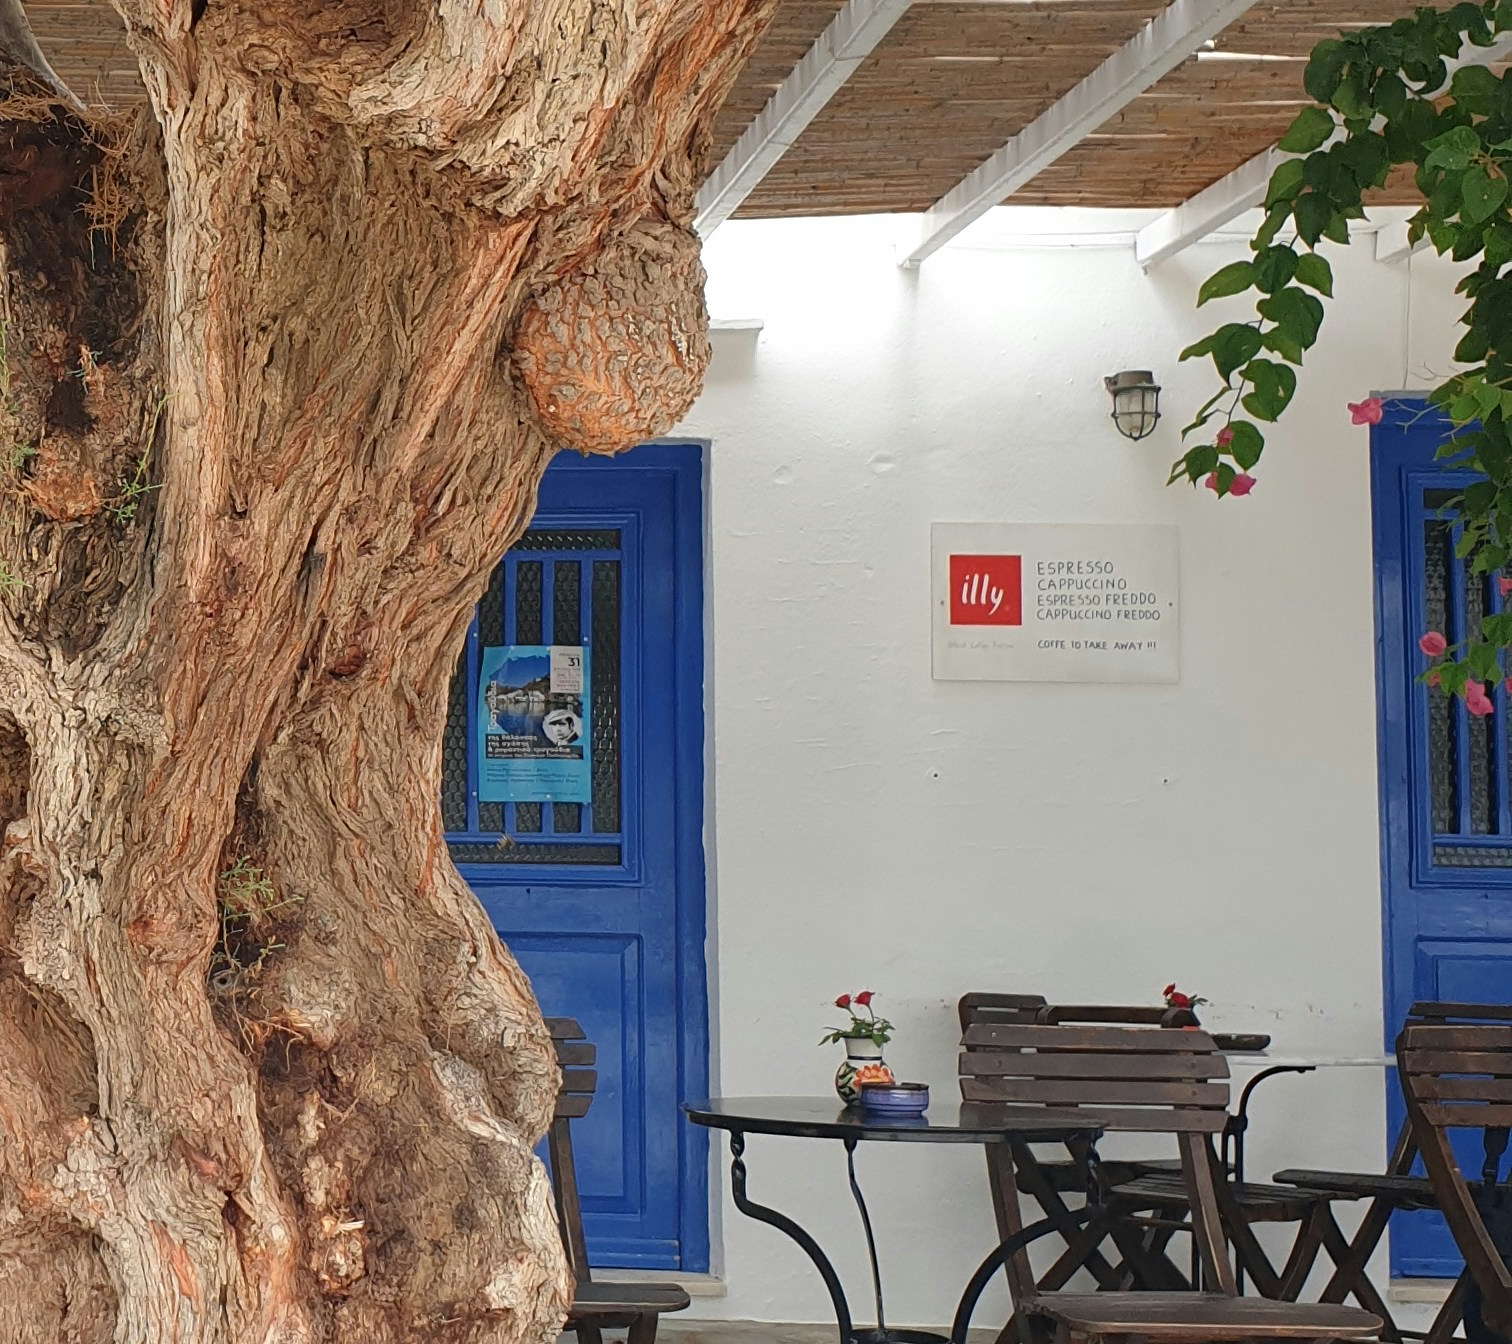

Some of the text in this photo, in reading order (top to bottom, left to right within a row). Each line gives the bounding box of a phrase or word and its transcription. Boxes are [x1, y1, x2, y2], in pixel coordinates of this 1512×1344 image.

[1037, 560, 1114, 575] ESPRESSO
[1037, 578, 1127, 591] CAPPUCCINO
[961, 572, 1004, 616] illy
[1037, 592, 1157, 607] ESPRESSO FREDDO
[1036, 608, 1161, 621] CAPPUCCINO FREDDO
[1084, 640, 1108, 650] TAKE
[1114, 641, 1143, 651] AWAY
[568, 656, 580, 667] 31
